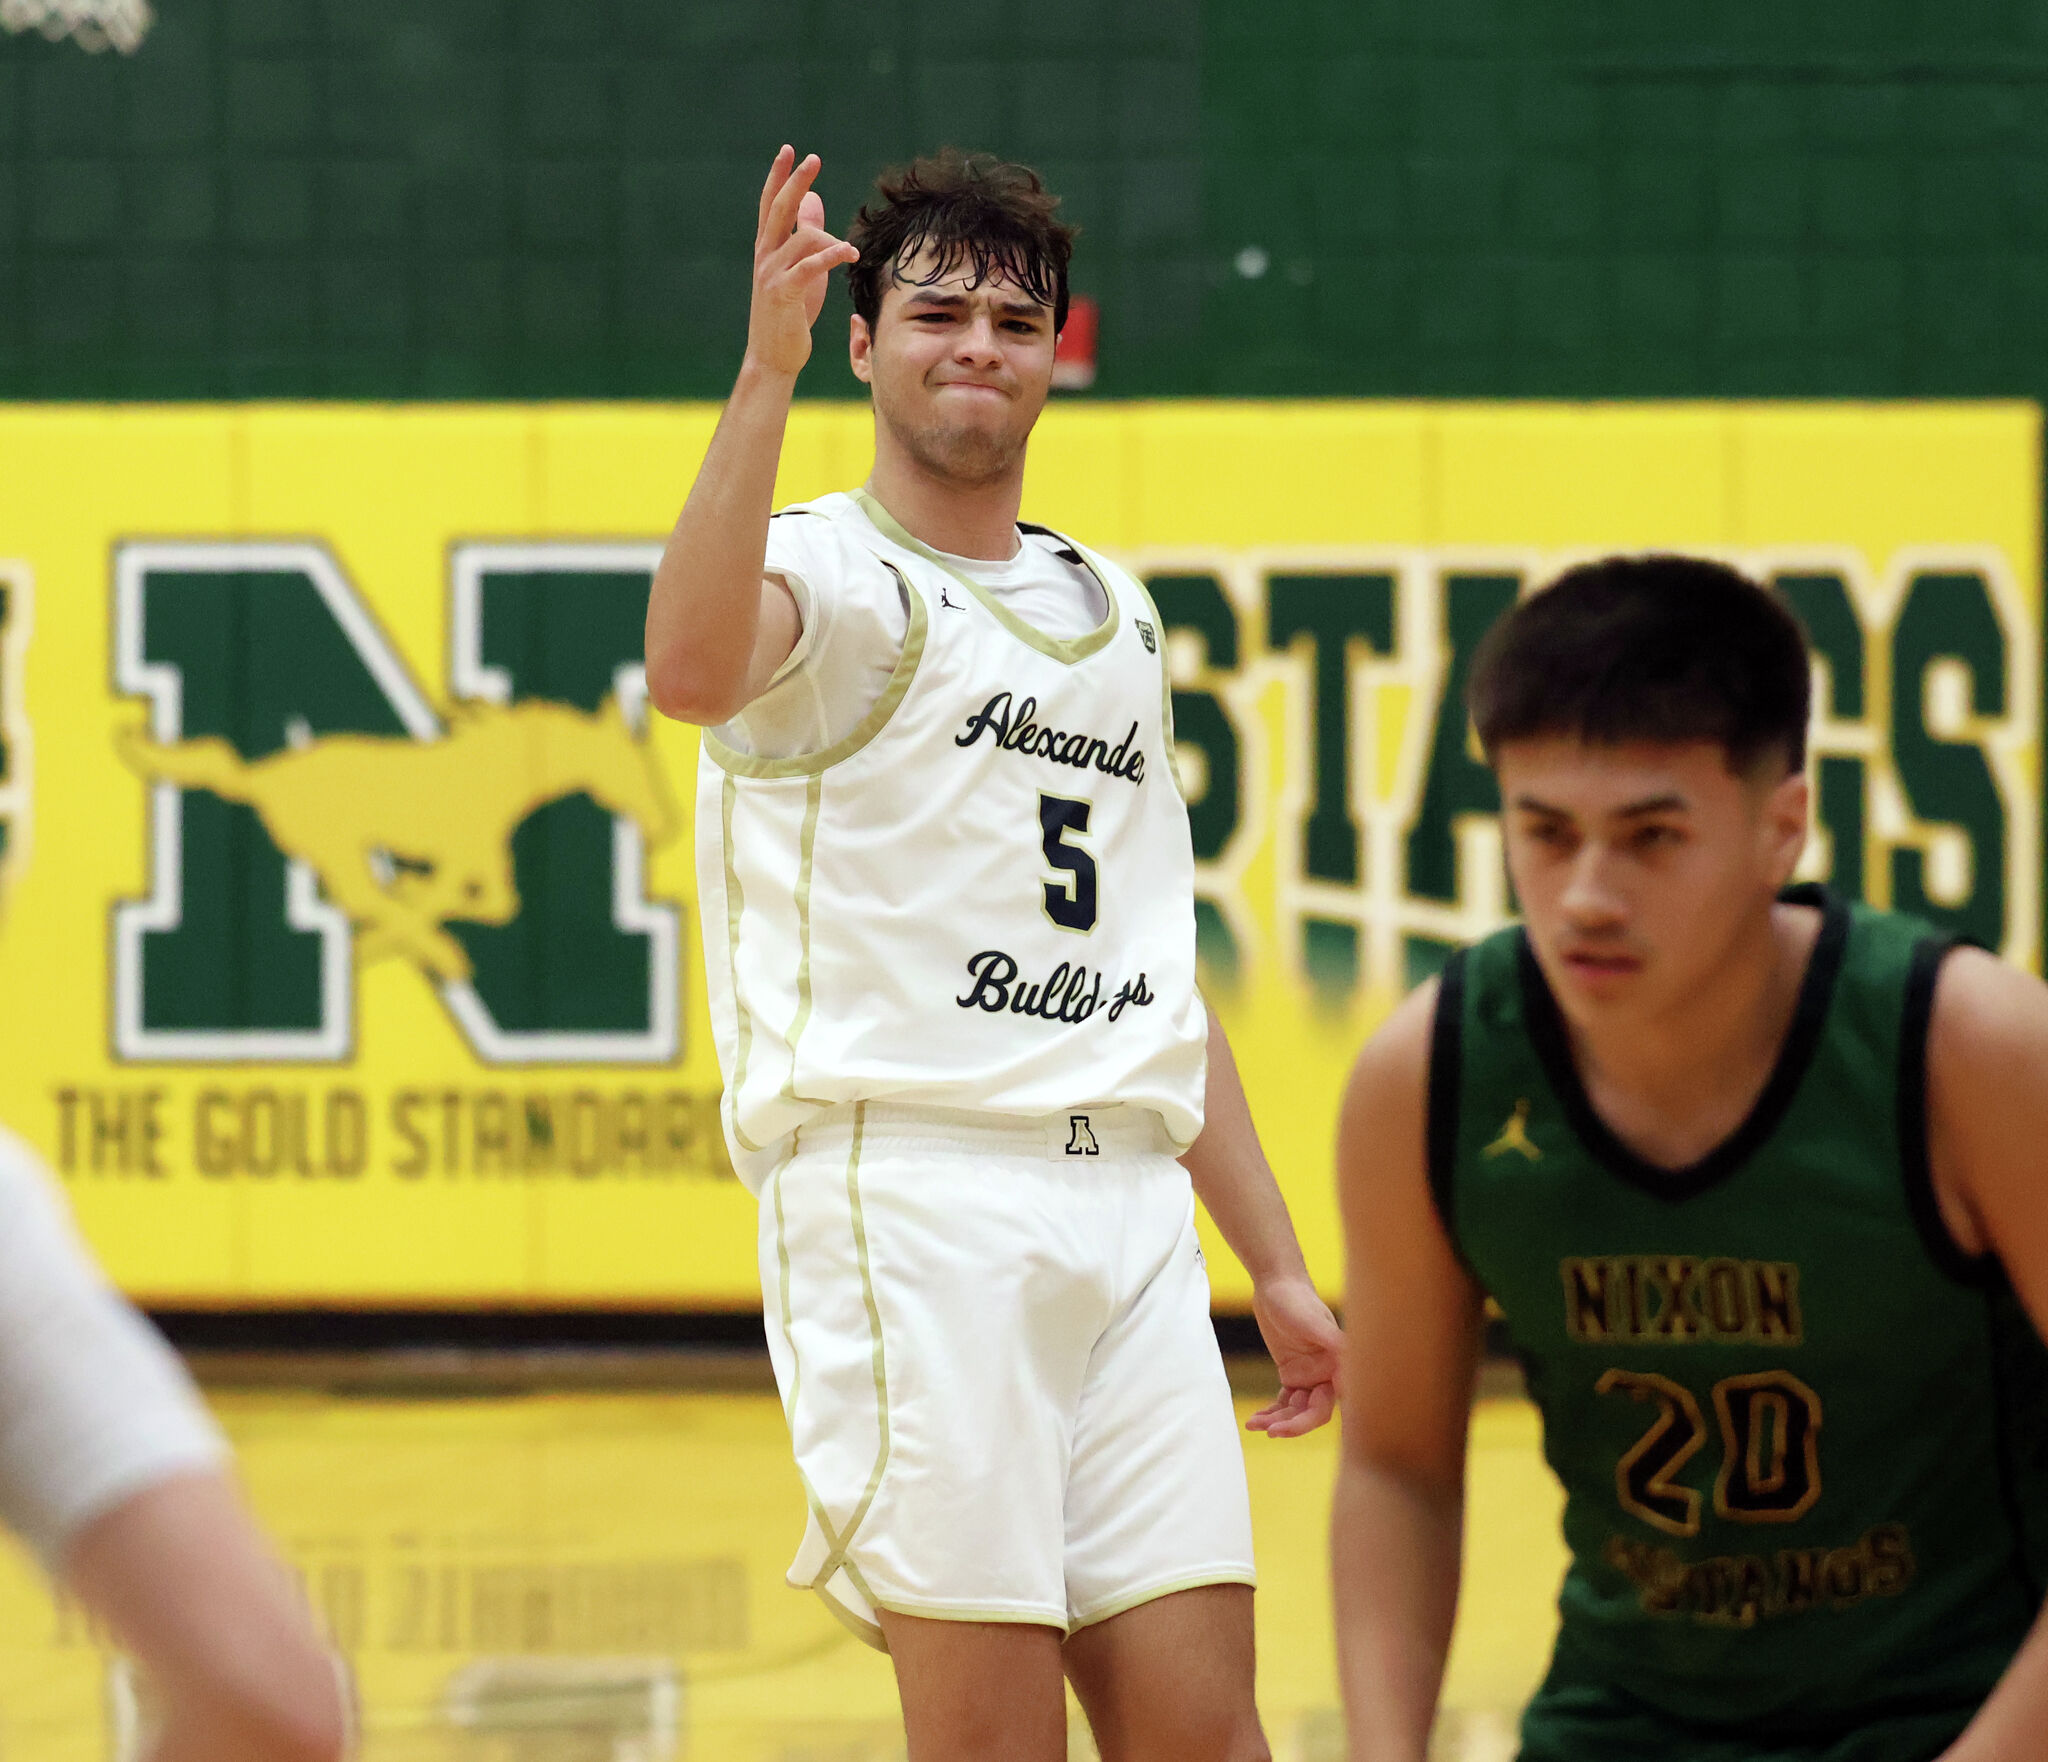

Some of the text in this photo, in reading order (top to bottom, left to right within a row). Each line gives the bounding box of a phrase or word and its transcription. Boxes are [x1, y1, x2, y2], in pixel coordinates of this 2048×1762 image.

[955, 691, 1146, 787] Alexande
[112, 536, 688, 1065] N
[1036, 788, 1100, 937] 5
[956, 950, 1154, 1024] Bulldgs
[56, 1086, 166, 1180] THE
[194, 1086, 366, 1180] GOLD
[1065, 1115, 1099, 1155] A
[1560, 1254, 1803, 1347] NIXON
[1594, 1368, 1822, 1537] 20
